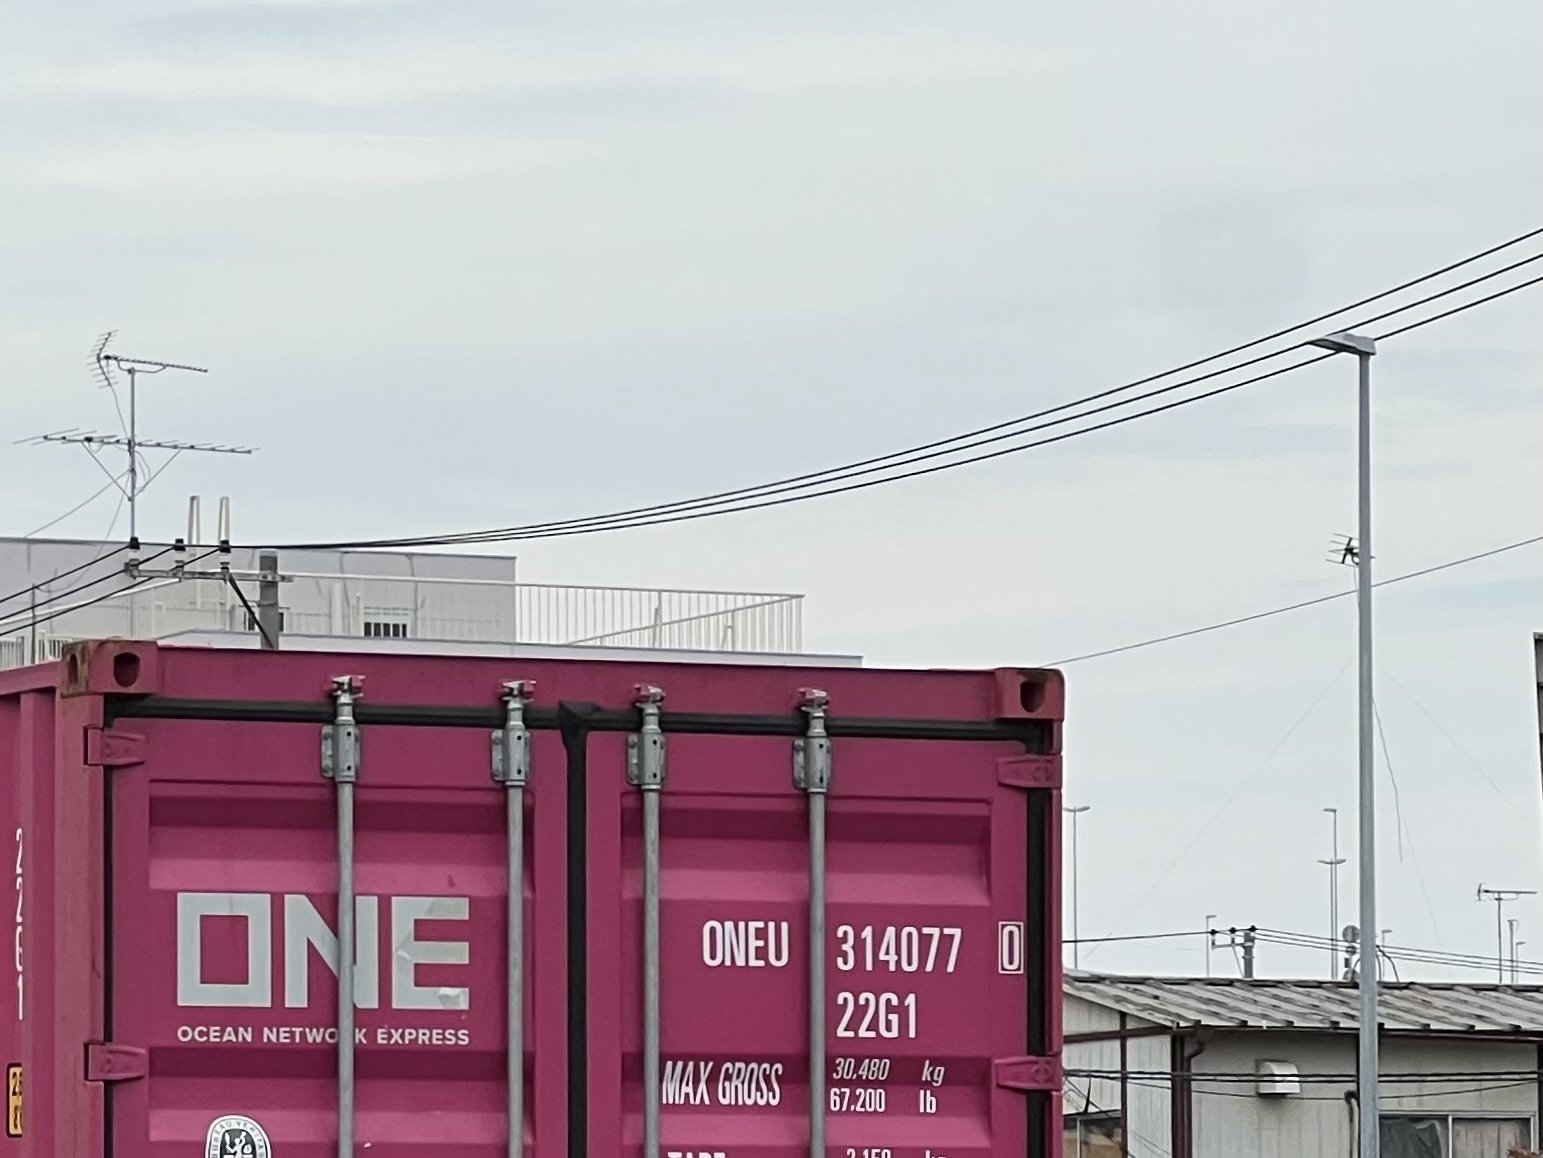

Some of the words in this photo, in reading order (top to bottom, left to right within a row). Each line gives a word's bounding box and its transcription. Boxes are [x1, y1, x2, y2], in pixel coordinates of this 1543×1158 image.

[177, 893, 470, 1010] ONE
[702, 920, 789, 967] ONEU
[836, 925, 962, 973] 314077
[1001, 924, 1021, 971] 0
[177, 1026, 253, 1043] OCEAN
[263, 1027, 367, 1044] NETWOK
[377, 1028, 470, 1045] EXPRESS
[836, 992, 917, 1038] 22G1
[662, 1061, 713, 1105] MAX
[718, 1062, 783, 1106] GROSS
[922, 1060, 945, 1087] kg
[919, 1089, 937, 1114] lb
